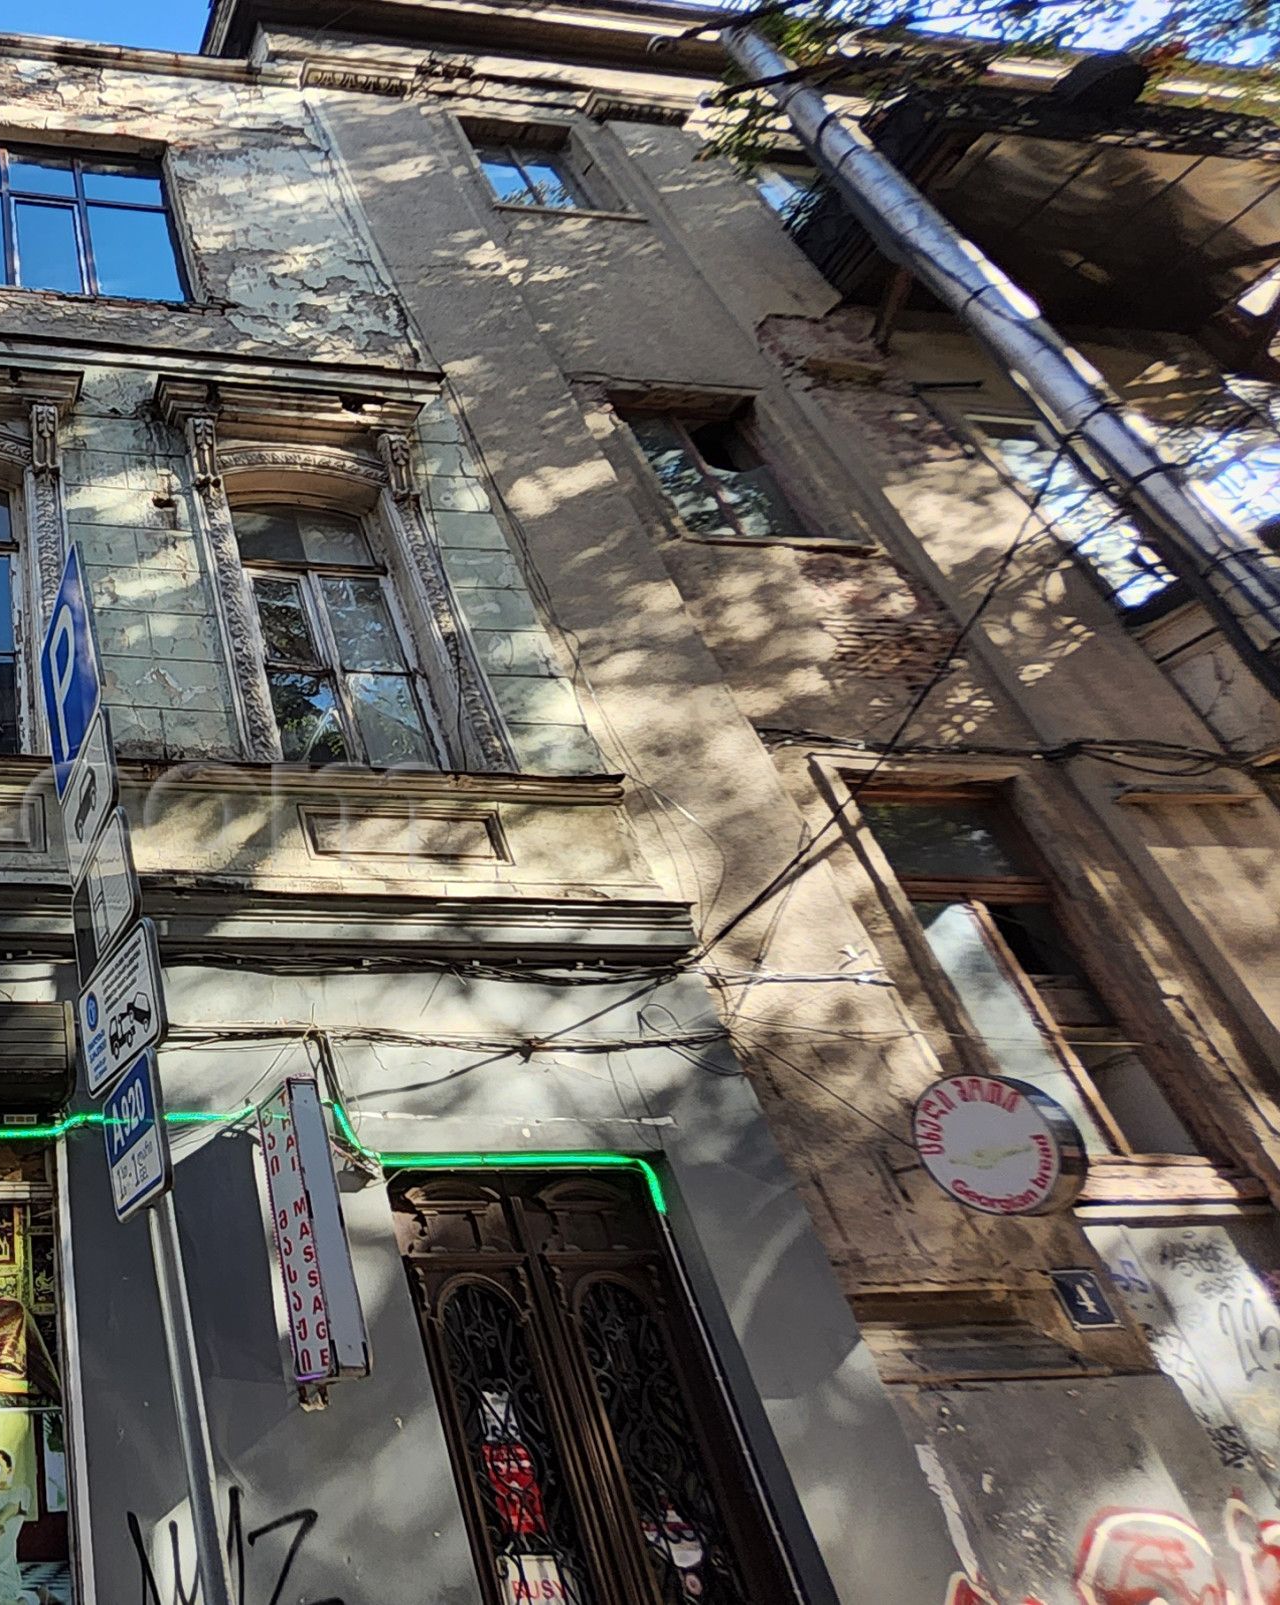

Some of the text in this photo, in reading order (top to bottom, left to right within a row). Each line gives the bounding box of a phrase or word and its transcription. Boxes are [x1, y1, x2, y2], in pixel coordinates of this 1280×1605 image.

[951, 1134, 1053, 1215] Georgian bread
[279, 1209, 312, 1371] მასაჟი
[293, 1196, 329, 1367] MASSAGE
[512, 1578, 569, 1602] BUSY
